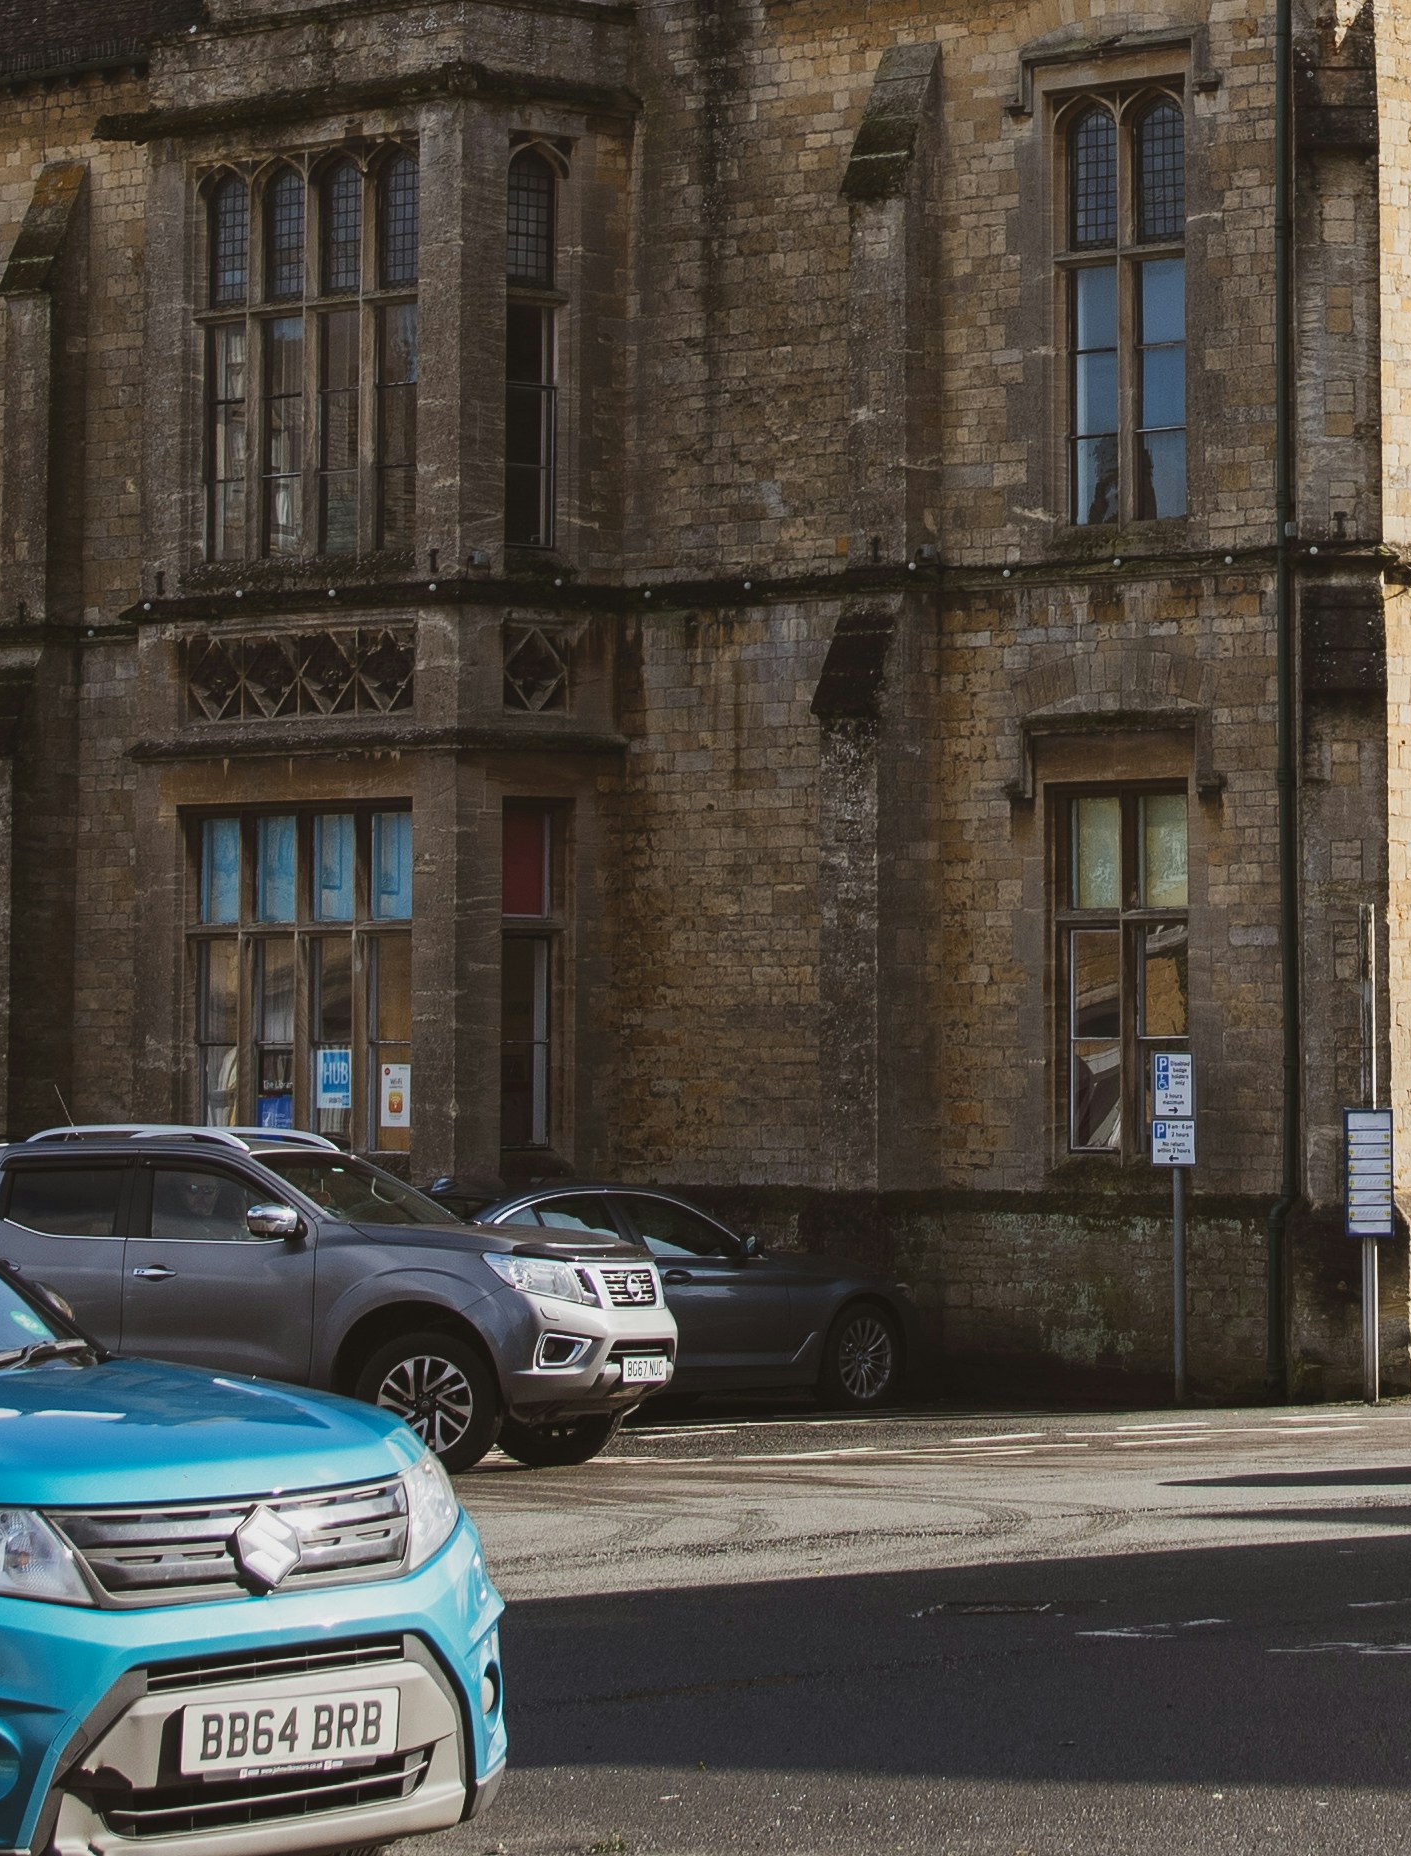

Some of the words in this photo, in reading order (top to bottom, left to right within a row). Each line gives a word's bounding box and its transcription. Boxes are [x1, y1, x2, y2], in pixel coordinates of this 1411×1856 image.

[323, 1062, 349, 1085] HUB
[628, 1360, 648, 1377] BG67
[200, 1706, 299, 1761] BB64
[311, 1699, 382, 1751] BRB
